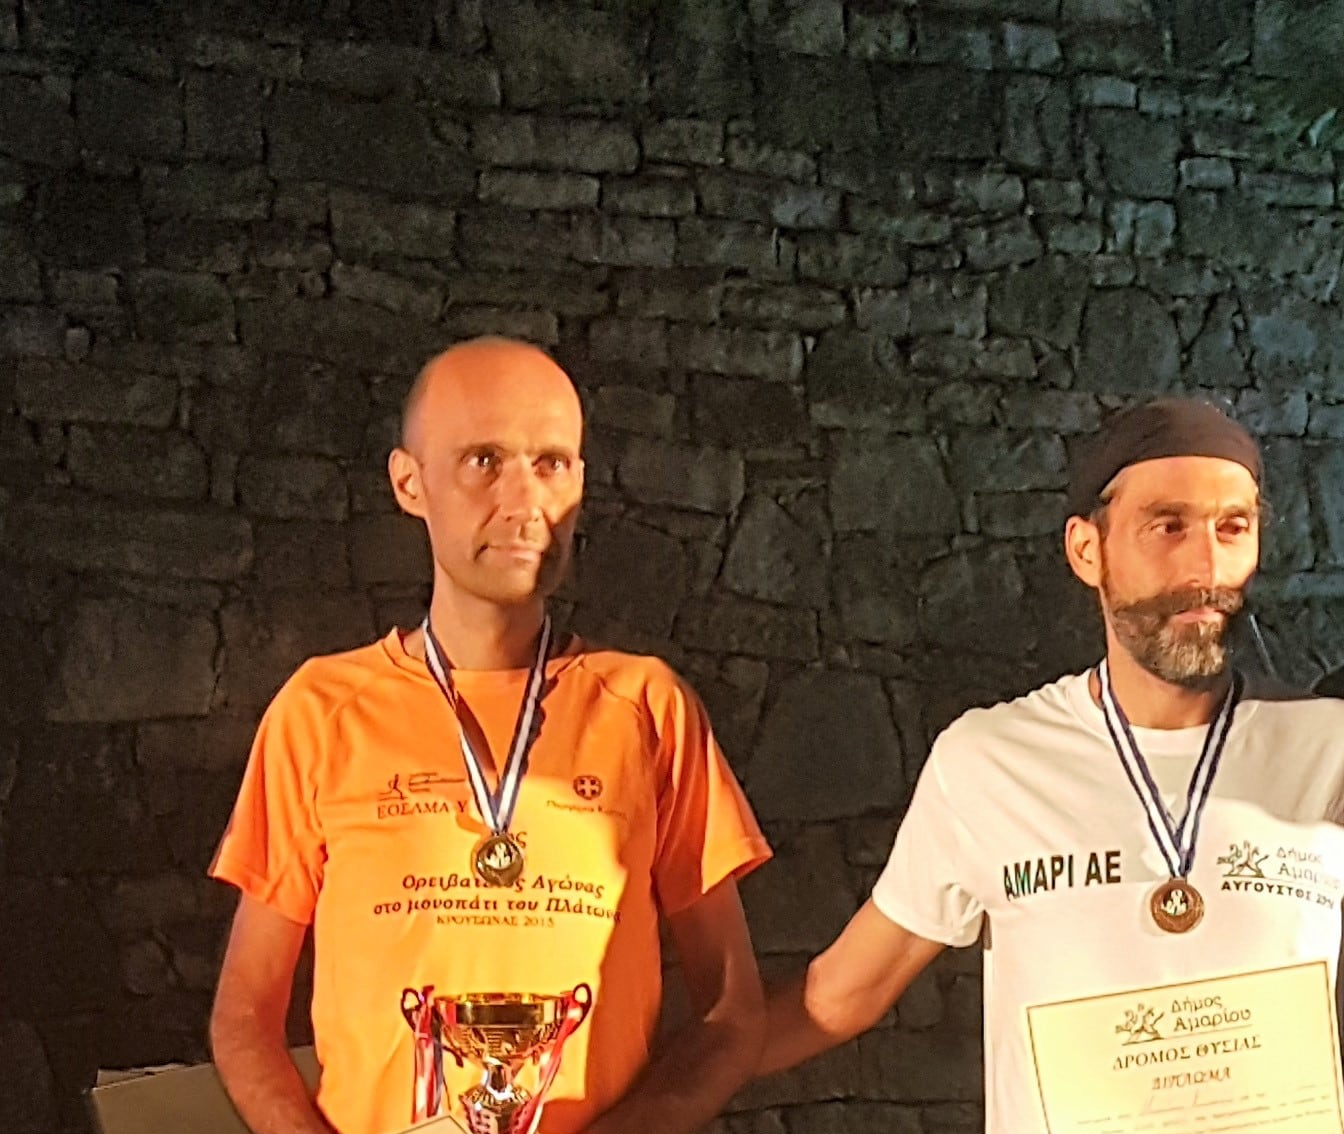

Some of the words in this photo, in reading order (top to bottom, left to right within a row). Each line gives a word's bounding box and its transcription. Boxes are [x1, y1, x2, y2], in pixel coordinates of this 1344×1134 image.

[531, 874, 606, 899] Αγώνας
[1002, 853, 1075, 902] ΑΜΑΡΙ
[1084, 850, 1122, 888] ΑΕ
[1220, 880, 1312, 901] ΑΥΓΟΥΣΤΟΣ
[373, 900, 402, 916] στο
[406, 894, 498, 915] μονοπάτι
[507, 900, 539, 912] του
[545, 896, 623, 923] Πλάτωνα
[1171, 996, 1224, 1014] Δήμος
[1173, 1007, 1253, 1033] Αμαρίου
[1112, 1045, 1191, 1071] ΔΡΟΜΟΣ
[1196, 1034, 1262, 1058] ΘΥΣΙΑΣ
